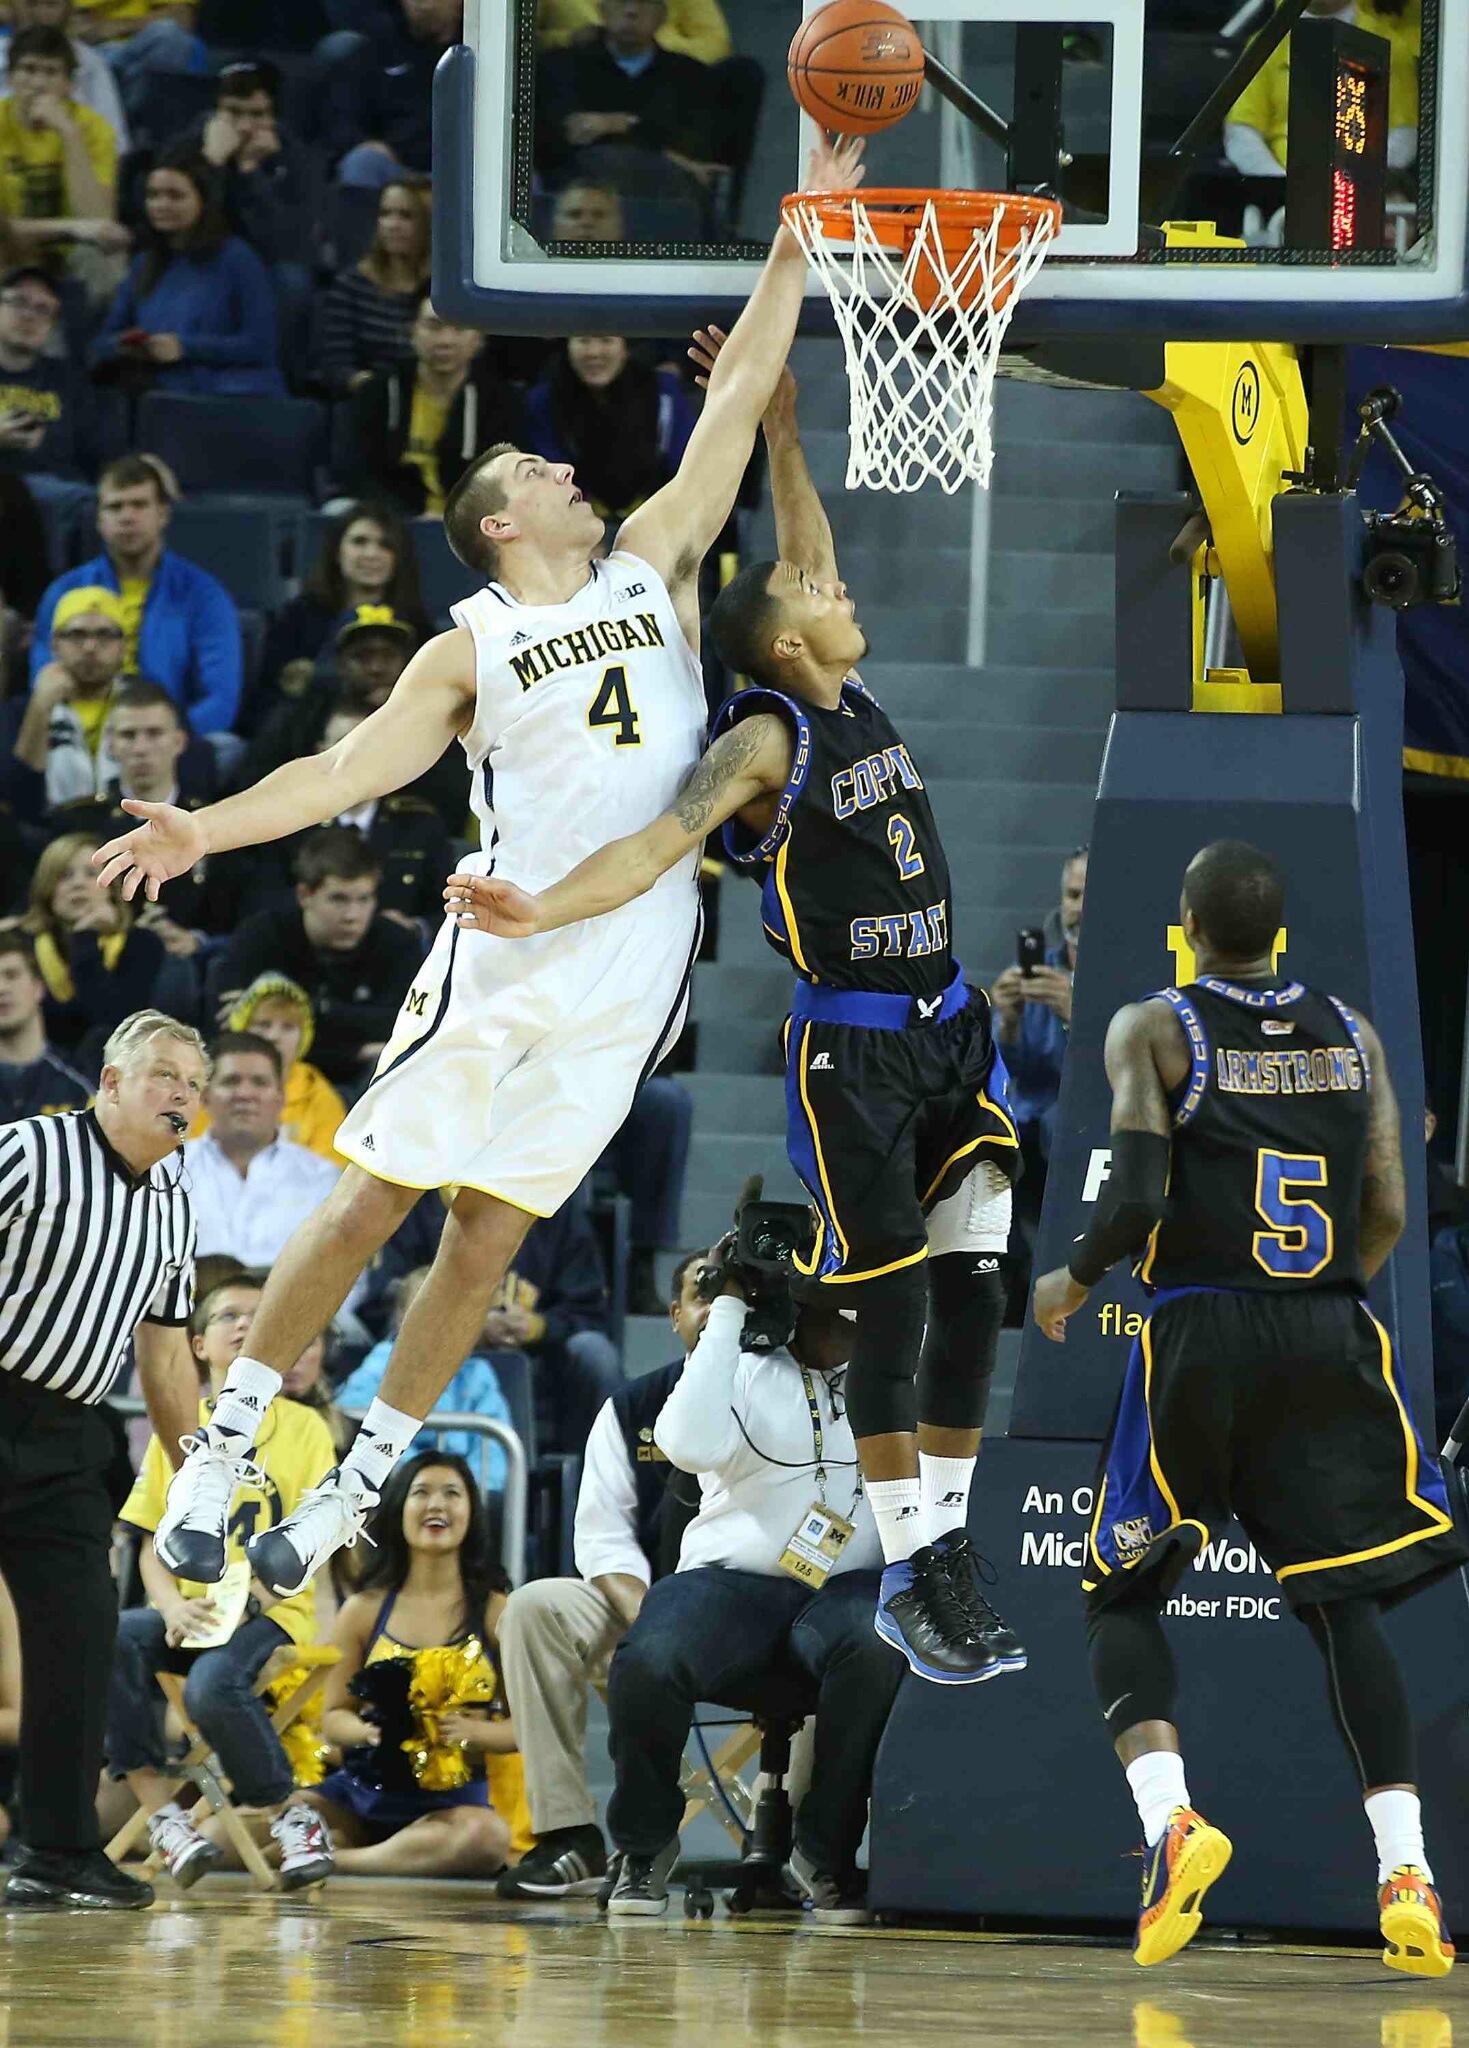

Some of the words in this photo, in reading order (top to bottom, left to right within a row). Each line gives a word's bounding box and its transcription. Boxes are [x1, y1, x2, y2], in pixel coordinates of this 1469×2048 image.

[508, 613, 666, 693] MICHIGAN
[586, 664, 644, 748] 4
[887, 813, 925, 880] 2
[850, 899, 948, 960] STAT
[406, 987, 429, 1017] M
[1216, 1046, 1363, 1095] ARMSTRONG
[1251, 1147, 1334, 1280] 5
[1098, 1303, 1143, 1336] fla
[1021, 1486, 1063, 1514] An
[1071, 1486, 1094, 1515] O
[1226, 1595, 1281, 1620] FDIC
